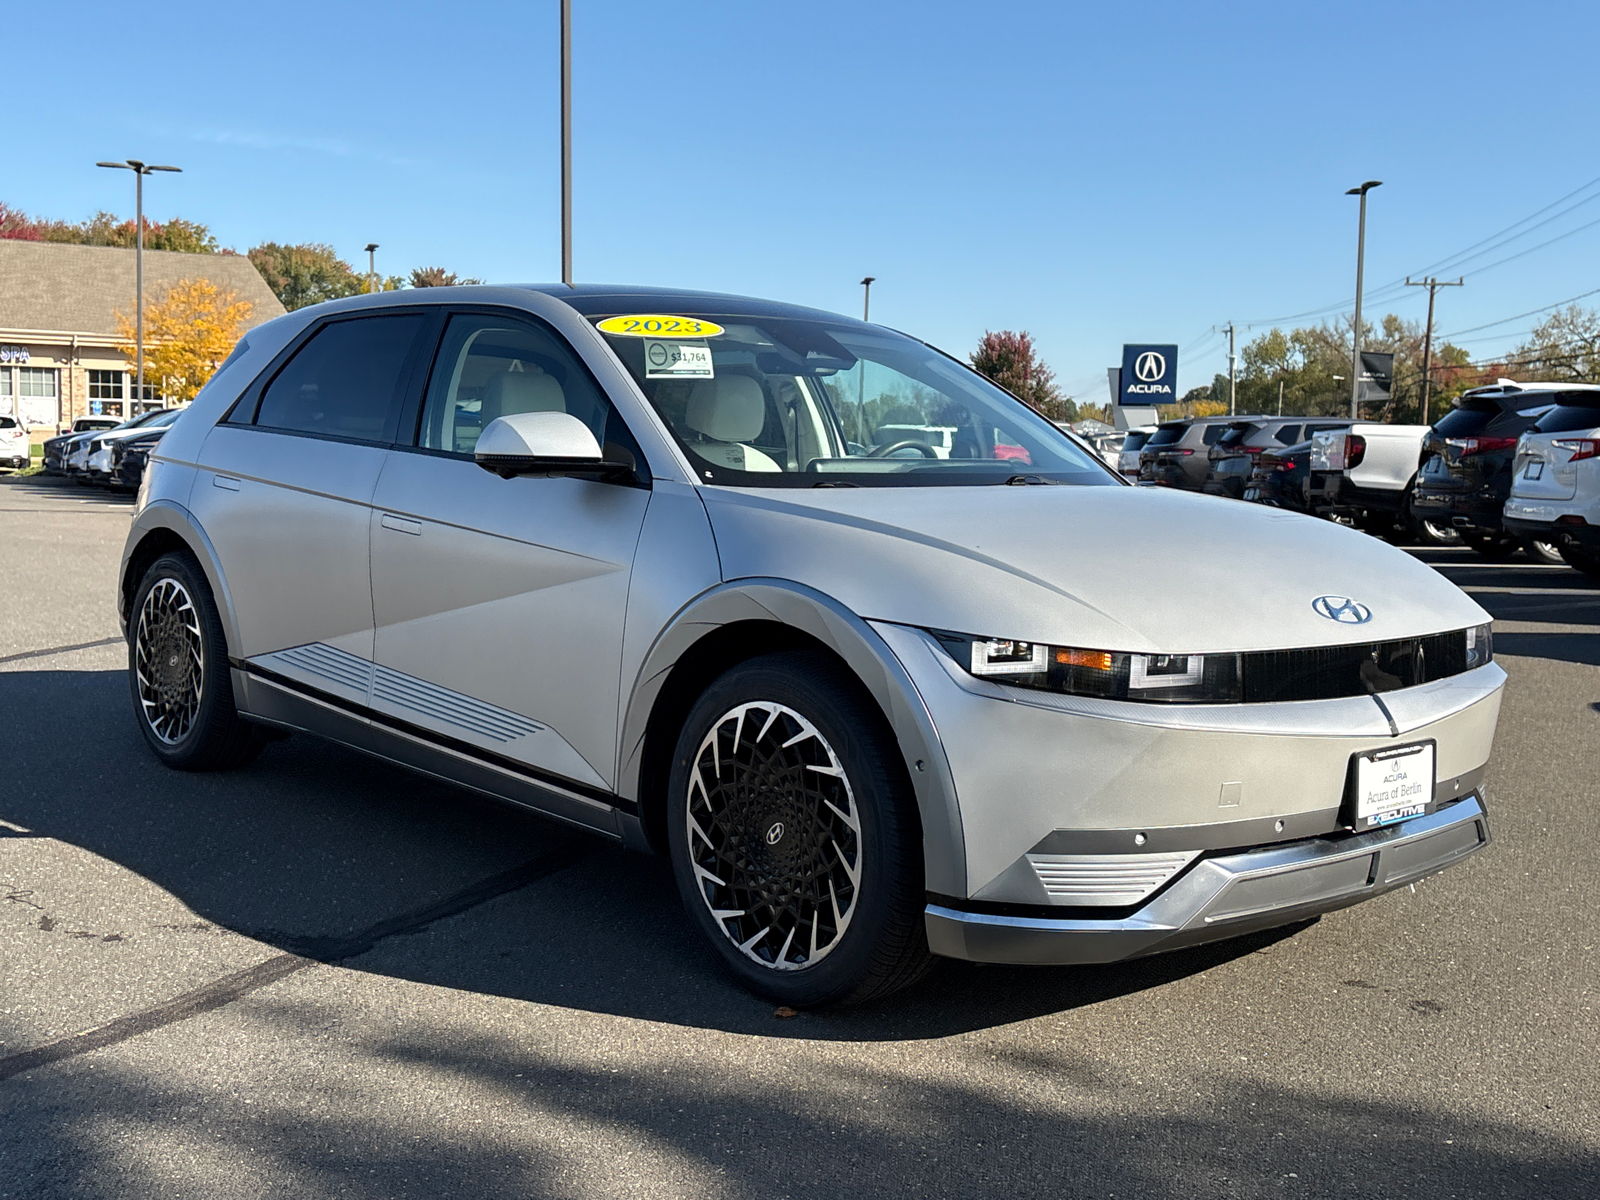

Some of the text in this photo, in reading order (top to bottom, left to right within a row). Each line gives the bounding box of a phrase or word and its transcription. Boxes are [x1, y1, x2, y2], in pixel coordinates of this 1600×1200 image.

[623, 320, 702, 332] 2023
[1, 346, 30, 360] SPA
[671, 352, 706, 363] $31,764
[1127, 384, 1172, 393] ACURA
[1383, 772, 1408, 784] ACURA
[1366, 781, 1422, 804] Acura of Berlin
[1367, 804, 1425, 825] EXECUTIVE
